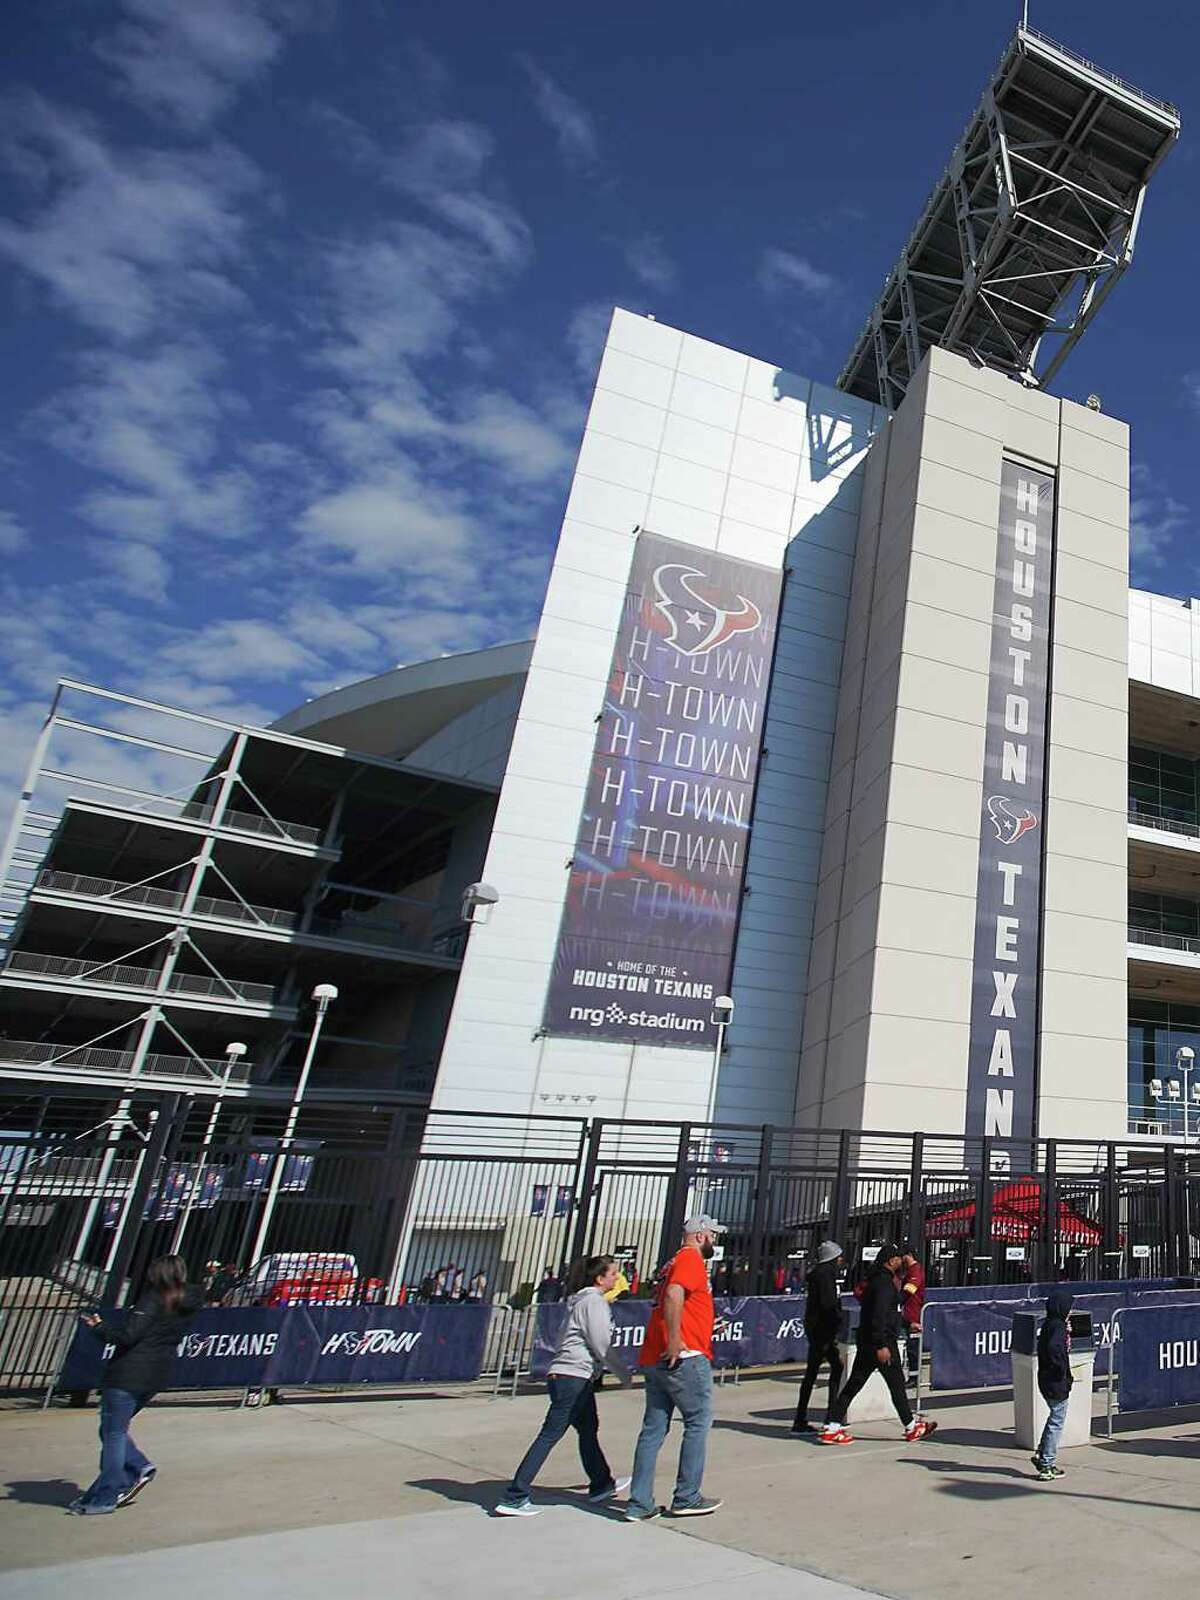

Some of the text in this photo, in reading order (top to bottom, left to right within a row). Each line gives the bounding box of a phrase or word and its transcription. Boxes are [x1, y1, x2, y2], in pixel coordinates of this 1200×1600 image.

[1002, 479, 1039, 785] HOUSTON
[619, 671, 757, 733] H-TOWN
[610, 719, 751, 779] H-TOWN
[601, 767, 745, 828] H-TOWN
[591, 818, 738, 876] H-TOWN
[572, 969, 714, 1000] HOUSTON TEXANS
[617, 960, 678, 977] HOME OF THE
[569, 1006, 706, 1032] nrg stadium
[207, 1333, 279, 1358] TEXANS
